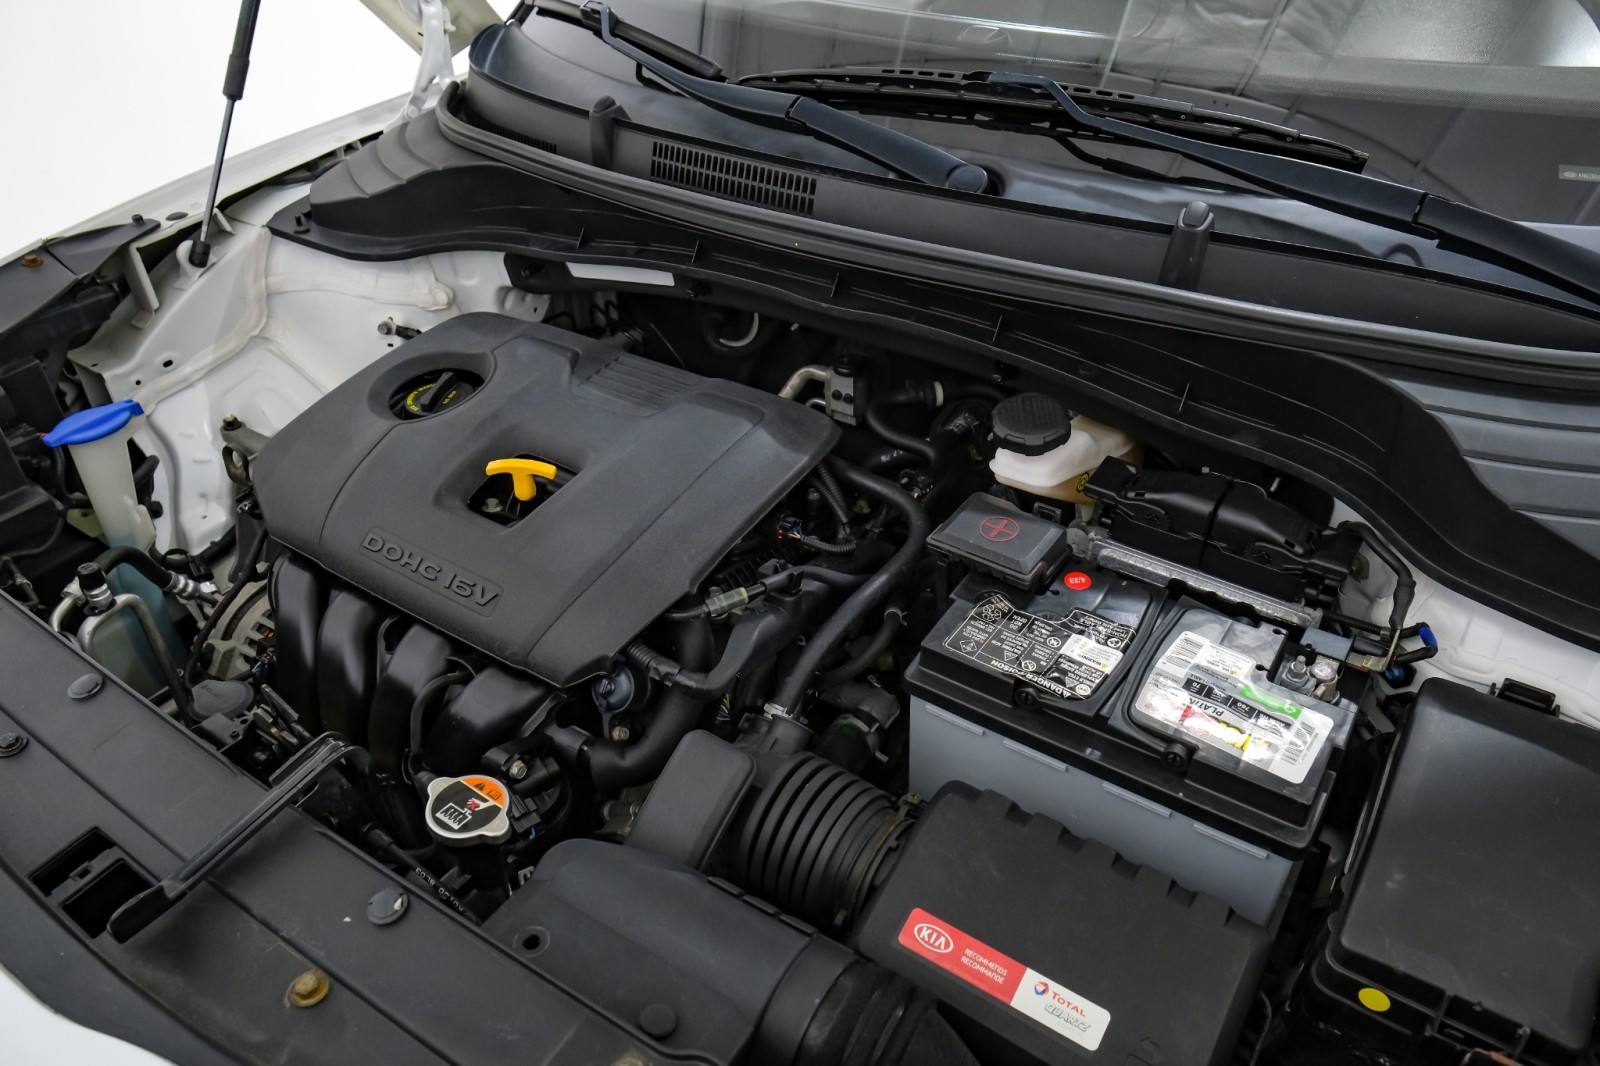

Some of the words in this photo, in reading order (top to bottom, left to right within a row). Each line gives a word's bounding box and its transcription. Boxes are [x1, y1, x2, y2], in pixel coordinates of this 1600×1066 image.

[362, 532, 442, 582] DOHC
[443, 571, 499, 607] 16V
[1236, 702, 1250, 710] 760
[919, 925, 947, 951] KIA
[961, 956, 1004, 985] RECOMMANDE
[964, 948, 1008, 977] RECOMMENDS
[1044, 1002, 1091, 1033] QUARTZ
[1051, 990, 1087, 1018] TOTAL
